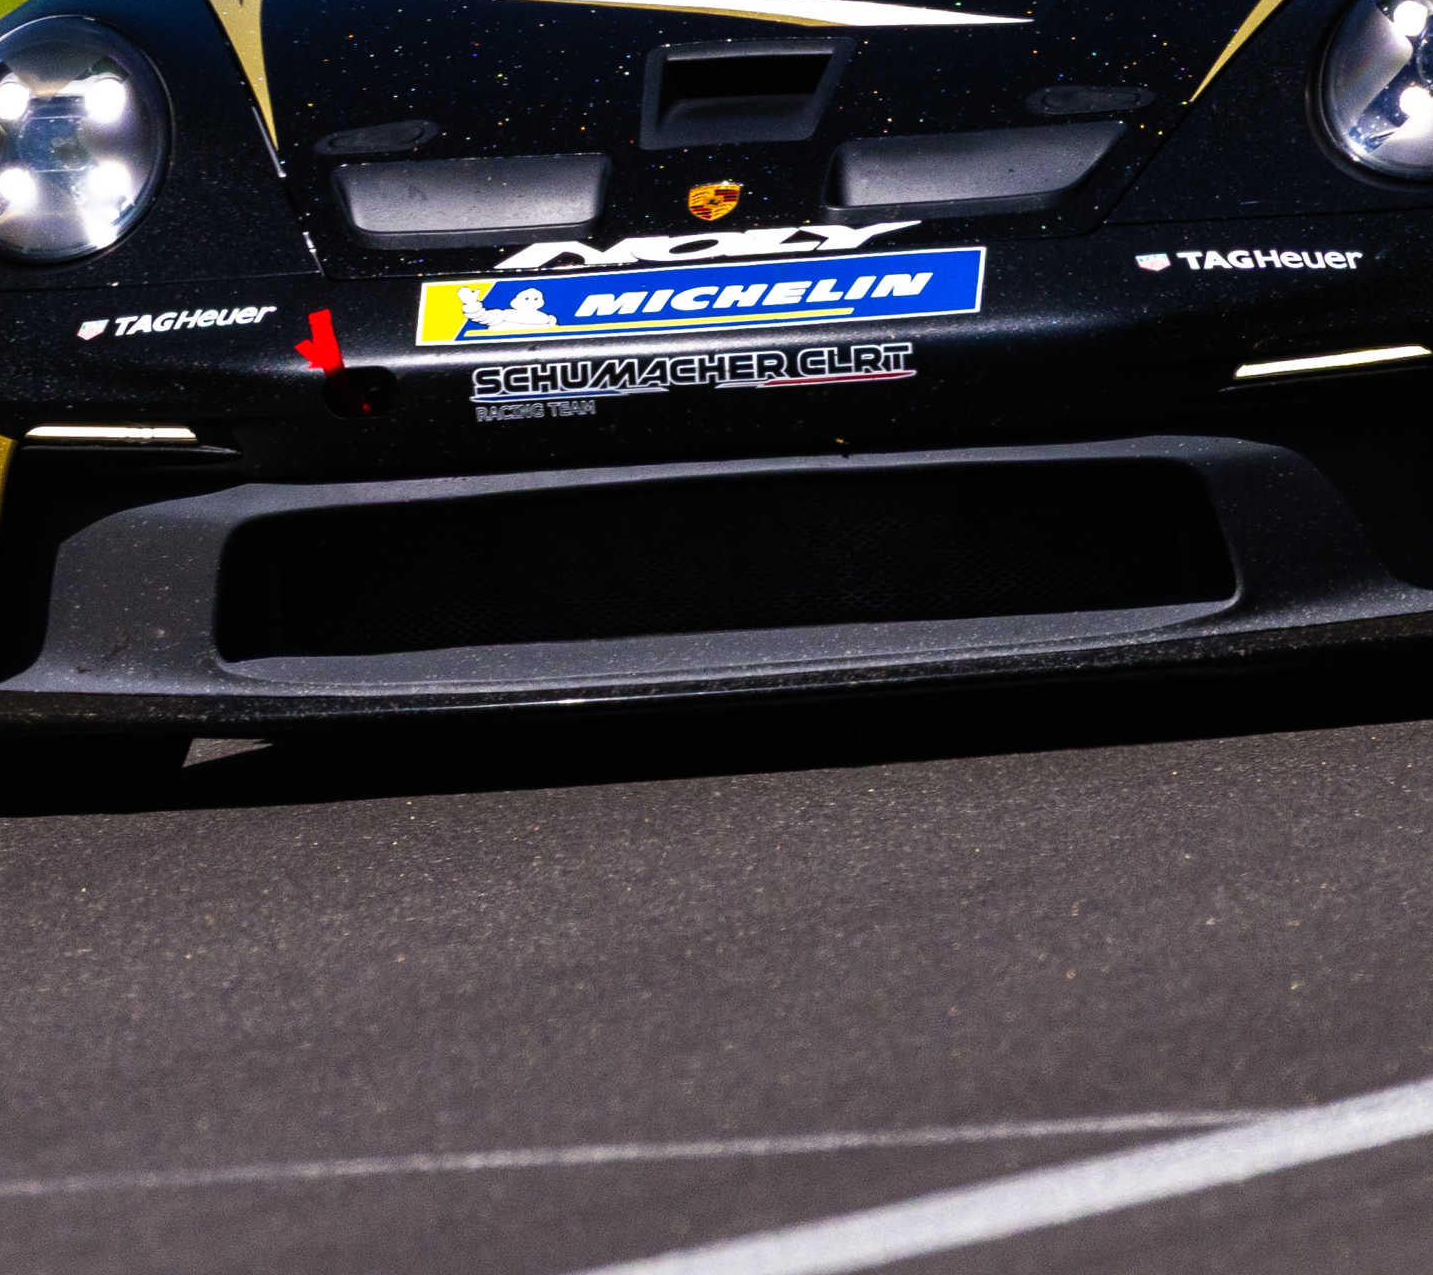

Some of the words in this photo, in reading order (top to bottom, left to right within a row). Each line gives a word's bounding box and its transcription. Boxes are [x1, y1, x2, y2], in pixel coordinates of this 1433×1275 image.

[574, 272, 934, 318] MICHELIN
[471, 350, 789, 396] SCHUMACHER
[796, 342, 913, 377] CLRT
[475, 402, 545, 422] RACING
[547, 399, 597, 418] TEAM
